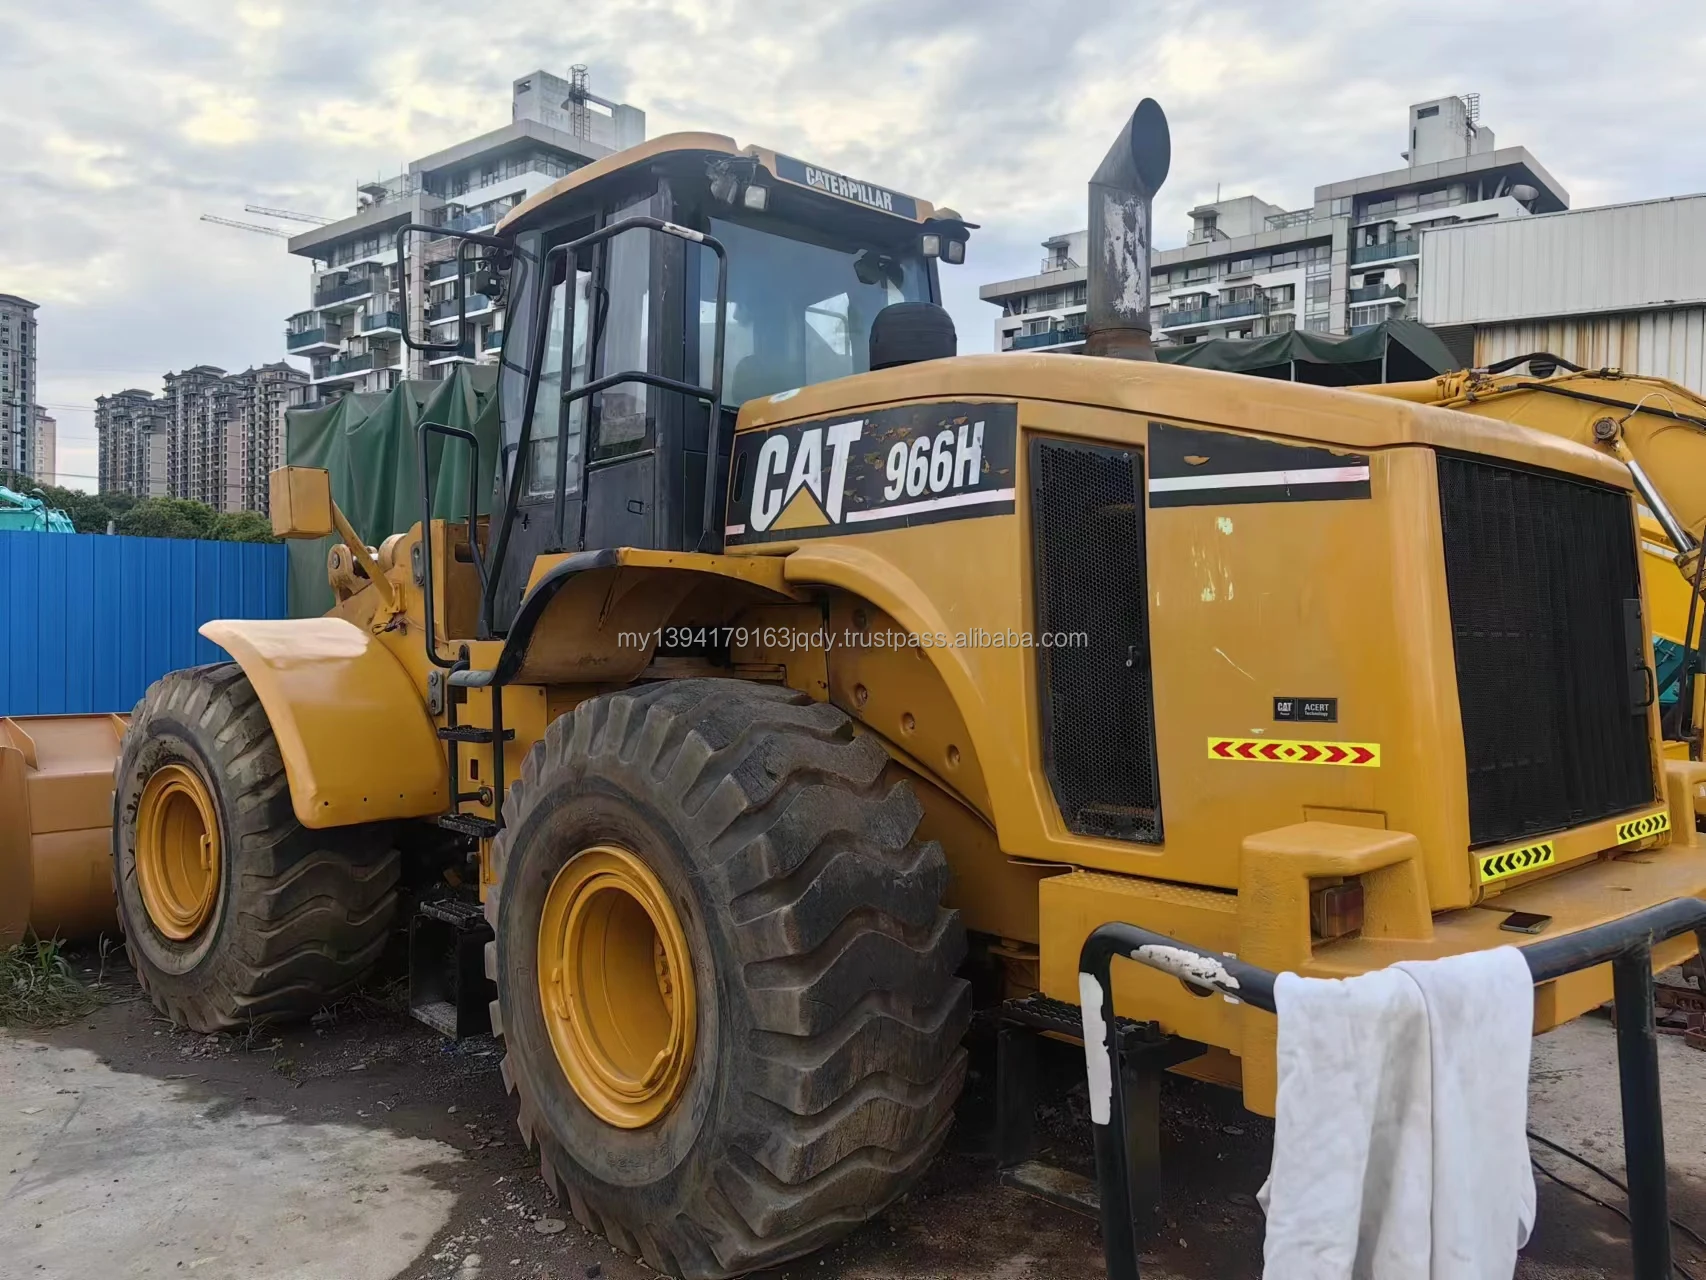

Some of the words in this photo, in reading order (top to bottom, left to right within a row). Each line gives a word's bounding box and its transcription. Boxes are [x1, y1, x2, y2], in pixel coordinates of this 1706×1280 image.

[805, 166, 892, 211] CATERPILLAR
[750, 419, 864, 531] CAT
[883, 420, 985, 501] 966H
[1277, 702, 1293, 711] CAT
[1304, 703, 1329, 711] ACERT
